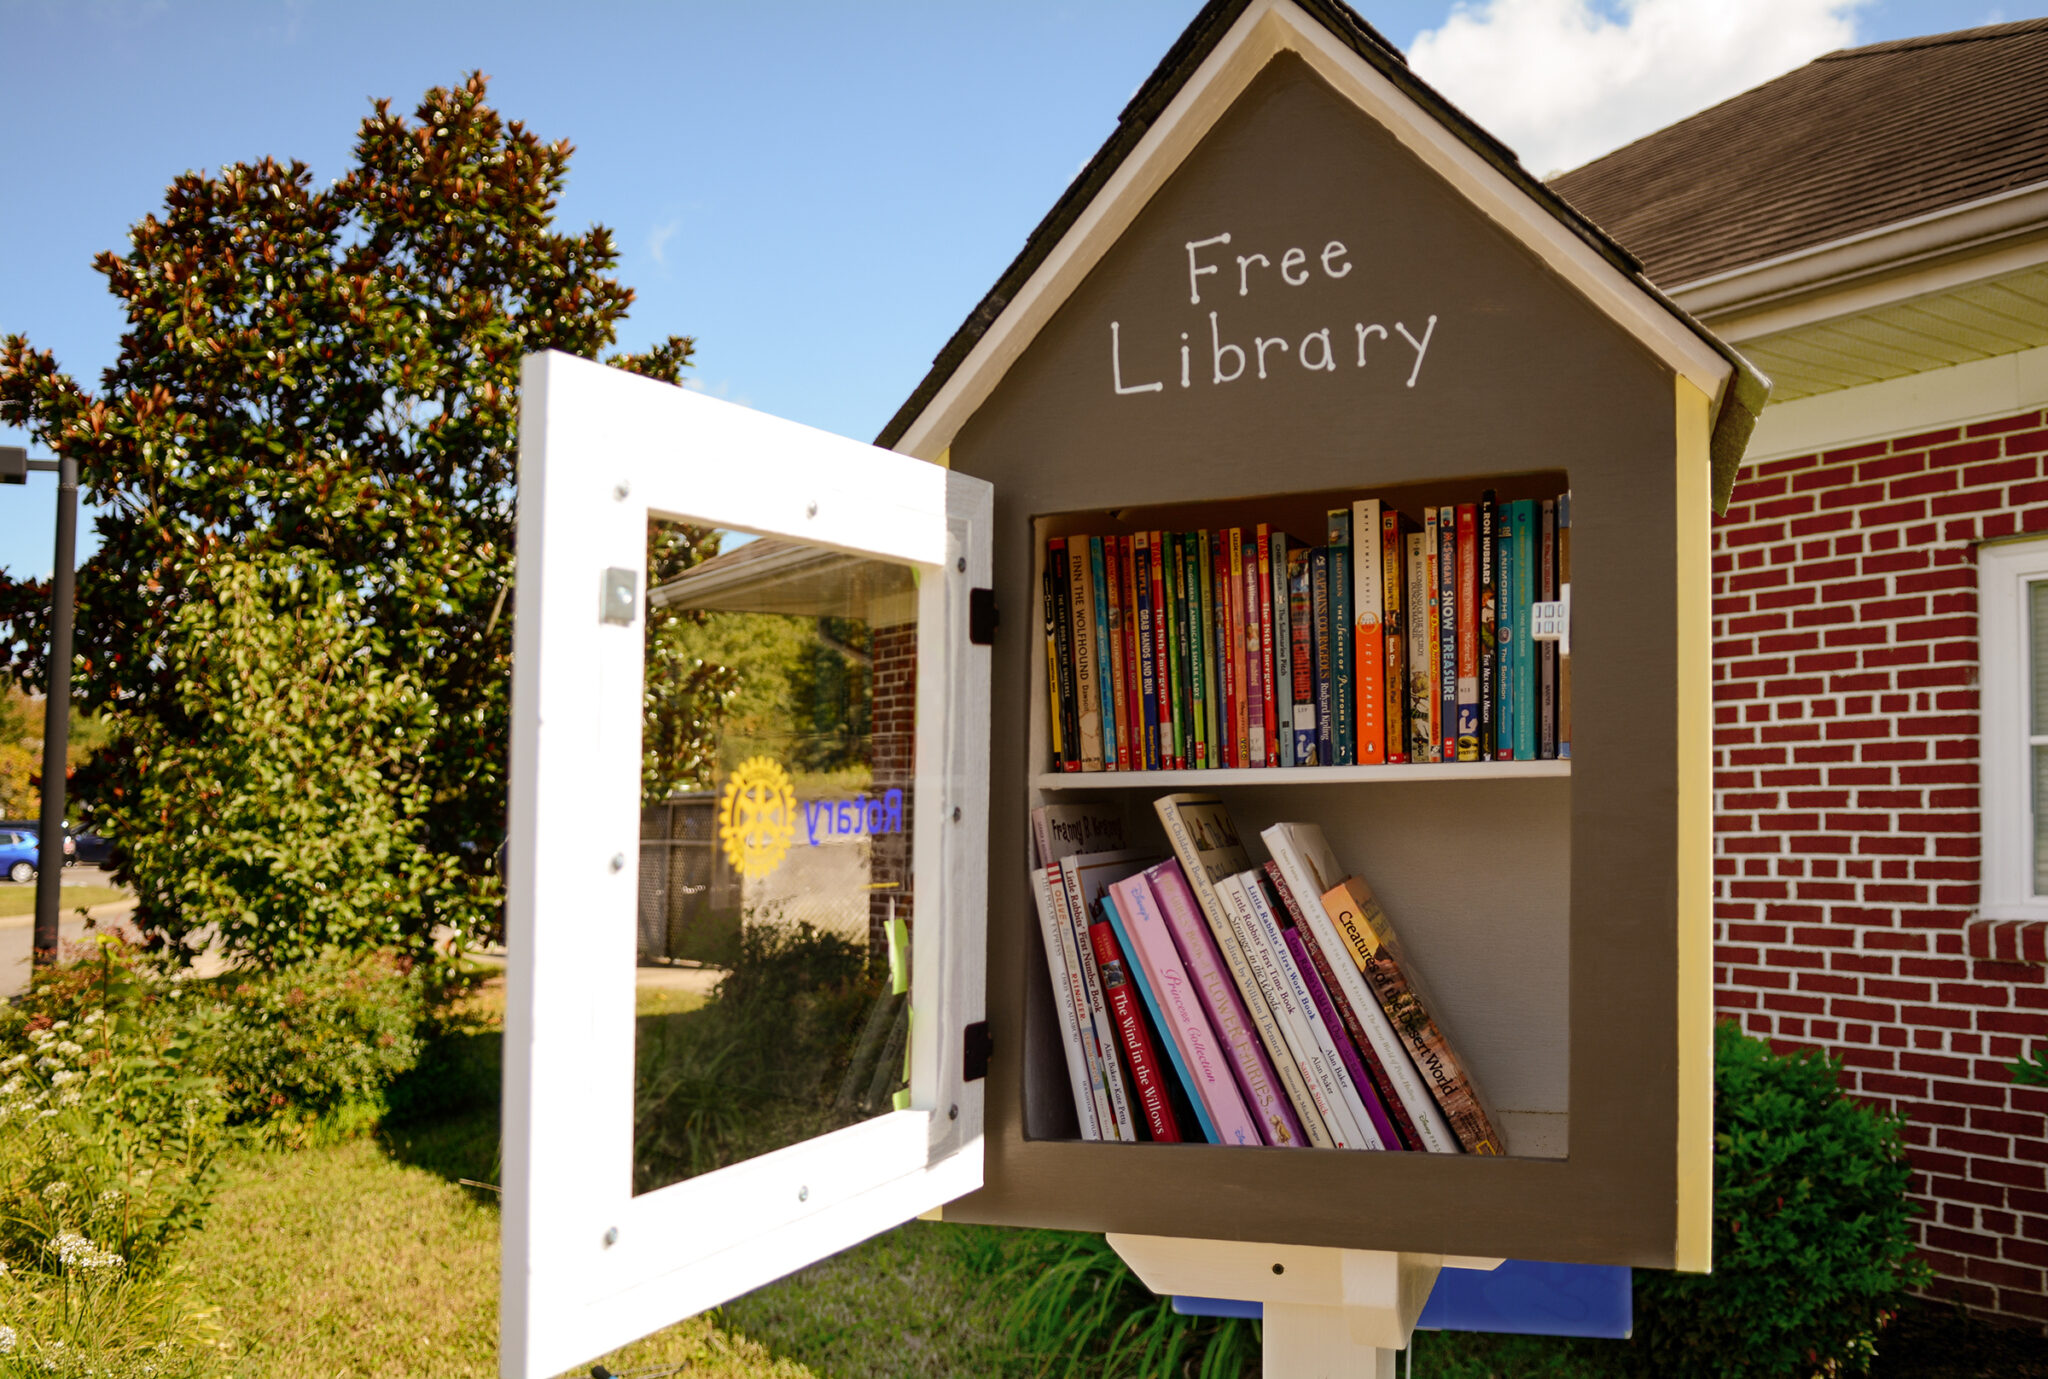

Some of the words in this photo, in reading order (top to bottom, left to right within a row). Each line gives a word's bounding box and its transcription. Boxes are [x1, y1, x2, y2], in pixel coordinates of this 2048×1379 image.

[1185, 232, 1352, 304] Free
[1110, 311, 1438, 394] Library
[1483, 501, 1490, 511] L.
[1150, 542, 1161, 567] BYARS
[1258, 535, 1269, 560] BYARS
[1463, 544, 1471, 563] JOAN
[1072, 555, 1083, 581] FINN
[1137, 554, 1146, 596] TEMPLE
[1073, 585, 1084, 606] THE
[1315, 569, 1327, 615] CAPTAINS
[1139, 608, 1149, 631] GRAB
[1155, 607, 1163, 624] The
[1262, 601, 1270, 619] The
[1442, 590, 1453, 630] SNOW
[1464, 596, 1472, 622] NIXON
[1156, 627, 1164, 649] 18th
[1189, 609, 1197, 649] AMERICA'S
[1263, 623, 1271, 644] 18th
[1278, 622, 1286, 657] Submarine
[1075, 609, 1089, 680] WOLFHOUND
[1140, 632, 1151, 658] HANDS
[1318, 615, 1328, 678] COURAGEOUS
[1142, 660, 1152, 676] AND
[1156, 652, 1167, 705] Emergency
[1262, 647, 1273, 701] Emergency
[1338, 659, 1343, 669] OF
[1443, 635, 1454, 700] TREASURE
[1062, 667, 1070, 698] UNIVERSE
[1081, 684, 1089, 711] Dawson
[1143, 678, 1153, 694] RUN
[1319, 682, 1329, 712] Rudyard
[1319, 714, 1330, 740] Kipling
[1065, 870, 1077, 892] Little
[1163, 804, 1177, 822] The
[1171, 821, 1197, 864] Children's
[1191, 865, 1207, 887] Book
[1201, 887, 1211, 897] of
[1207, 897, 1224, 928] Virtues
[1053, 890, 1068, 926] OLIVE,
[1069, 894, 1085, 930] Rabbits'
[1077, 931, 1089, 951] First
[1227, 911, 1253, 955] Stranger
[1232, 890, 1245, 912] Little
[1242, 913, 1264, 948] Rabbits'
[1259, 948, 1272, 968] First
[1268, 967, 1284, 991] Time
[1280, 990, 1295, 1014] Book
[1247, 885, 1261, 909] Little
[1260, 911, 1282, 945] Rabbits'
[1278, 949, 1293, 971] First
[1290, 972, 1304, 995] Word
[1301, 996, 1315, 1019] Book
[1248, 952, 1258, 963] in
[1082, 951, 1098, 988] Number
[1253, 962, 1266, 979] the
[1090, 989, 1103, 1012] Book
[1113, 991, 1129, 1016] The
[1224, 936, 1241, 965] Edited
[1237, 966, 1248, 978] by
[1244, 977, 1262, 1013] William
[1258, 1013, 1268, 1021] J.
[1263, 1022, 1282, 1056] Bennett
[1259, 977, 1281, 1012] Woods
[1338, 909, 1380, 973] Creatures
[1374, 969, 1393, 990] of
[1384, 986, 1408, 1012] the
[1396, 1010, 1434, 1058] Desert
[1423, 1053, 1458, 1097] World
[1160, 968, 1189, 1022] Princess
[1188, 1027, 1214, 1081] Collection
[1313, 988, 1327, 1006] Odd
[1321, 1006, 1335, 1022] One
[1330, 1024, 1343, 1042] Out
[1123, 1016, 1141, 1048] Wind
[1203, 971, 1243, 1039] FLOWER
[1235, 1042, 1274, 1108] FAIRIES
[1103, 1042, 1113, 1060] Alan
[1131, 1049, 1144, 1064] in
[1107, 1061, 1118, 1081] Baker
[1135, 1064, 1151, 1085] the
[1311, 1055, 1324, 1073] Alan
[1319, 1073, 1334, 1095] Baker
[1324, 1048, 1338, 1067] Alan
[1334, 1066, 1347, 1087] Baker
[1113, 1087, 1122, 1105] Kate
[1300, 1060, 1313, 1082] Sams
[1309, 1082, 1317, 1090] &
[1313, 1091, 1329, 1115] Stoick
[1118, 1106, 1127, 1125] Petty
[1143, 1085, 1164, 1135] Willows
[1300, 1100, 1313, 1123] Michael
